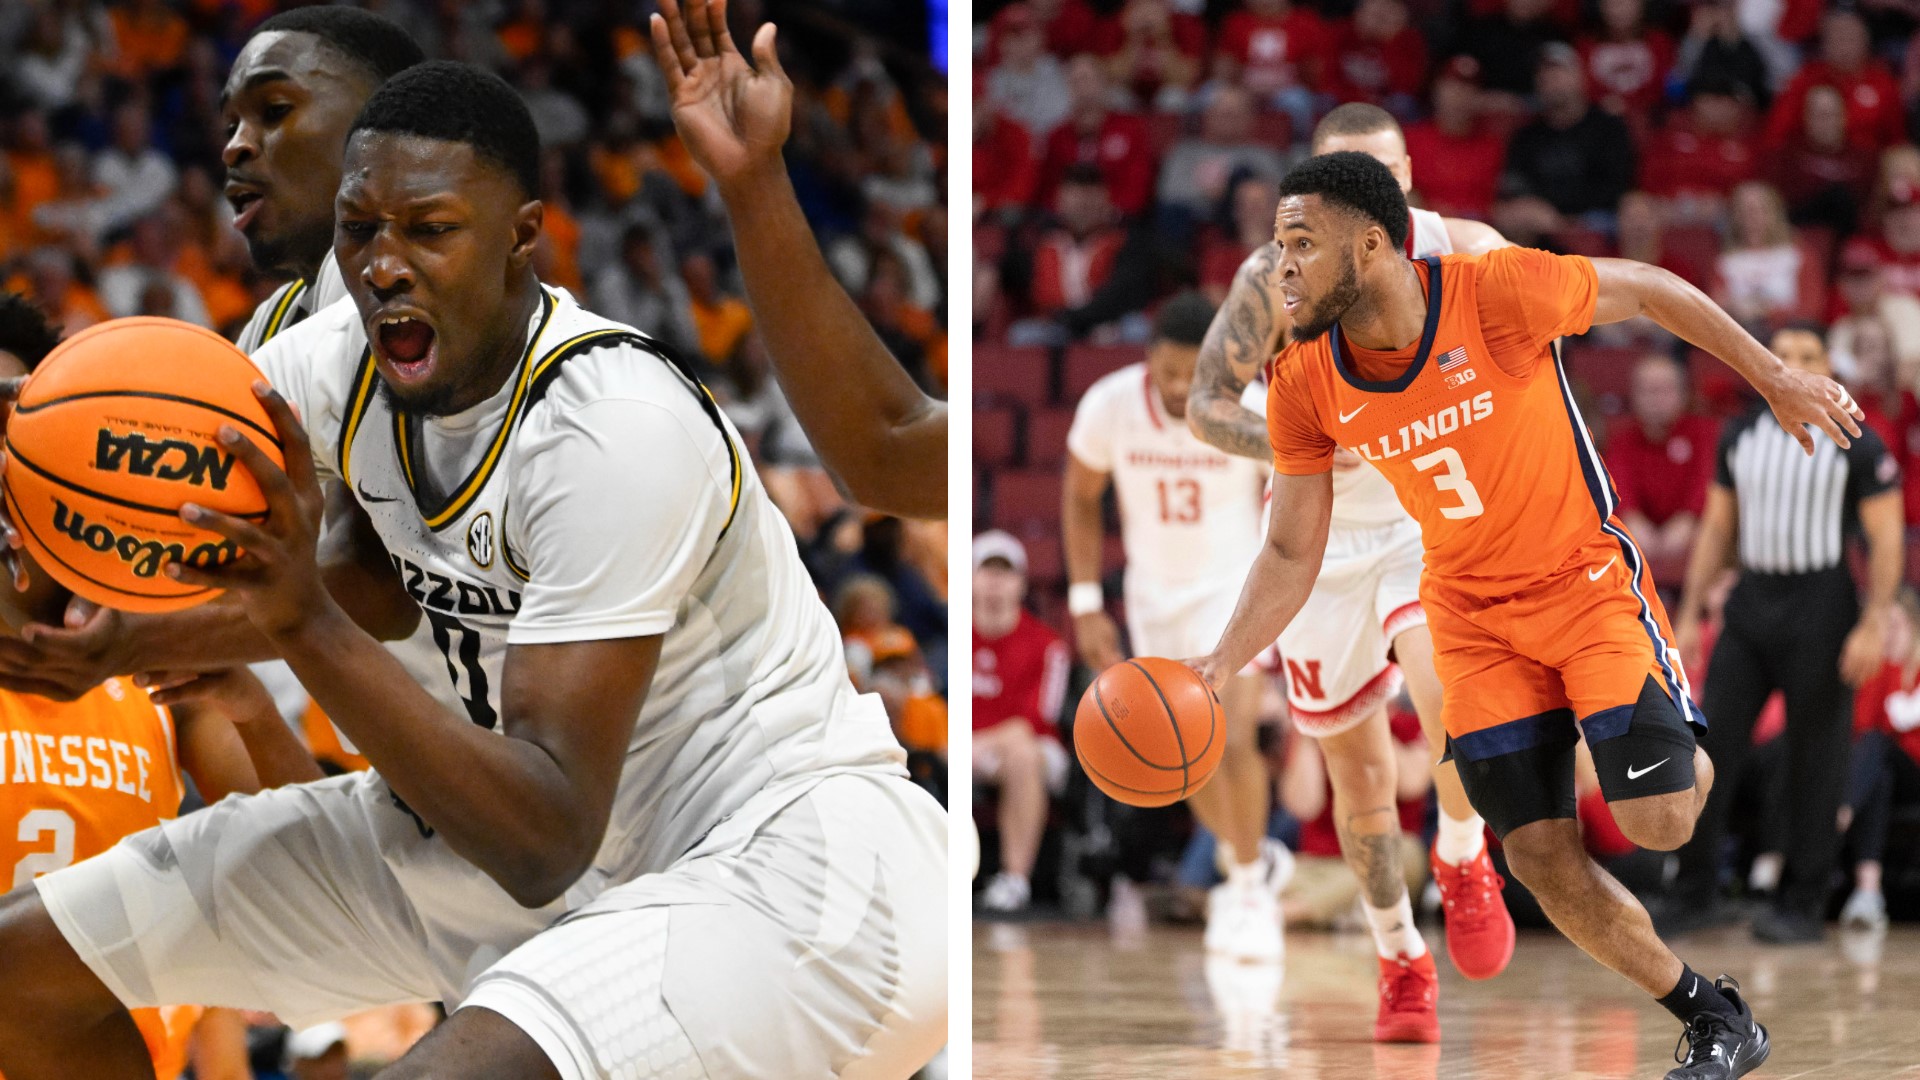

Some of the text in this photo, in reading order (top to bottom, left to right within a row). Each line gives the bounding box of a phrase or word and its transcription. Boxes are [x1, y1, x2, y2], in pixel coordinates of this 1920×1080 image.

[104, 415, 139, 427] BALL
[144, 421, 183, 434] GAME
[96, 428, 235, 491] NCAA
[1411, 446, 1484, 519] 3
[1156, 478, 1202, 524] 13
[1287, 659, 1325, 700] N
[12, 809, 76, 890] 2
